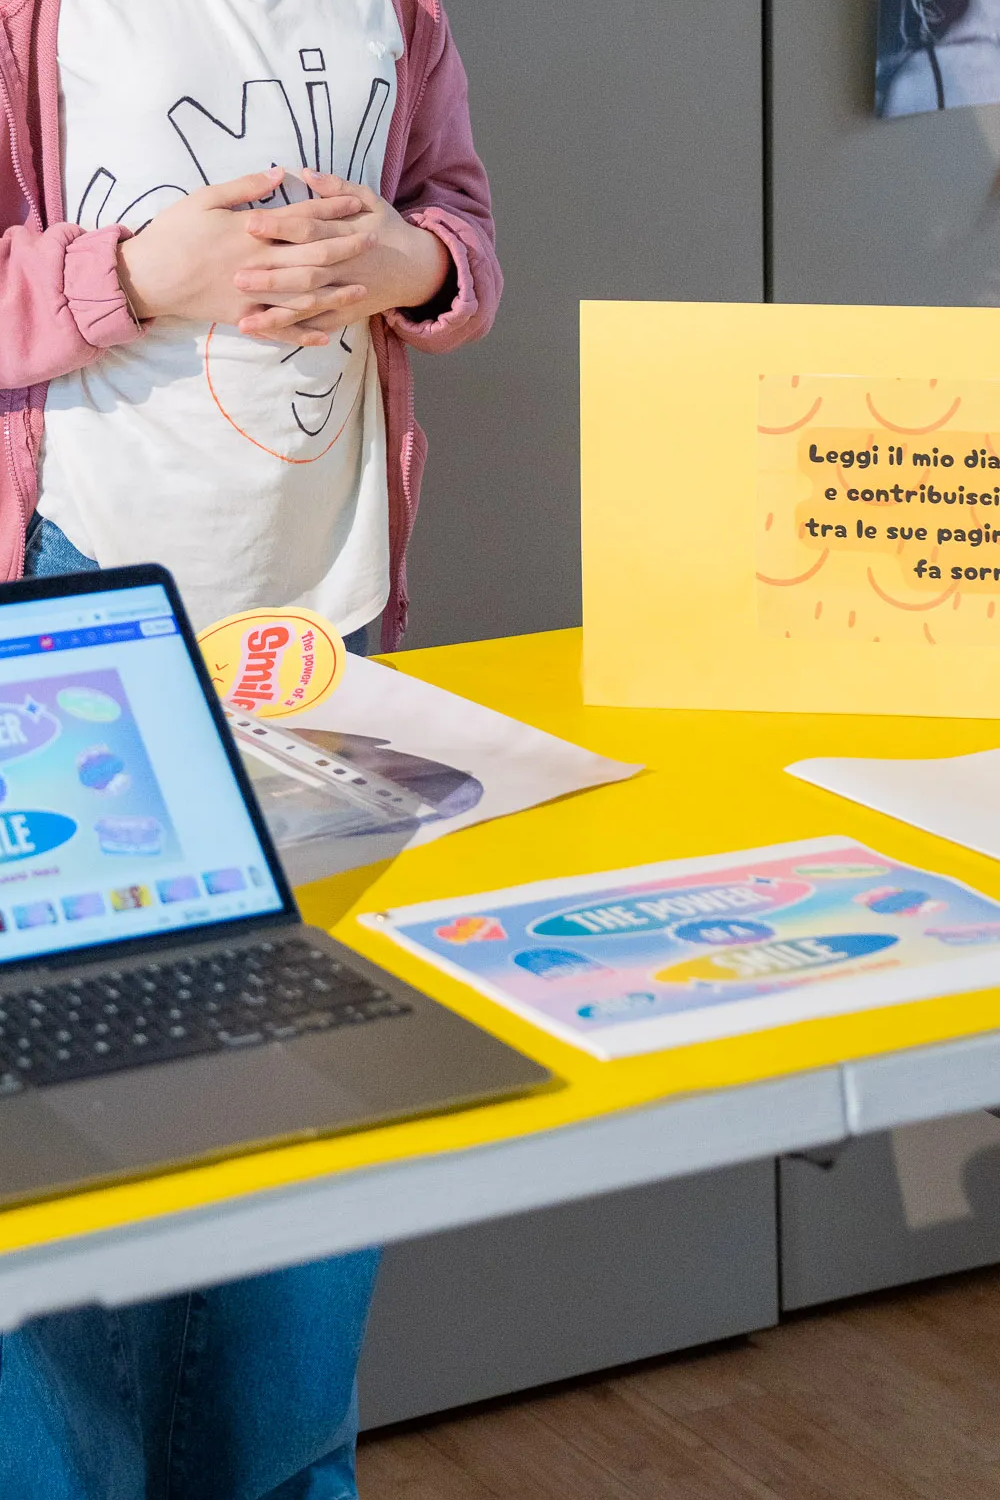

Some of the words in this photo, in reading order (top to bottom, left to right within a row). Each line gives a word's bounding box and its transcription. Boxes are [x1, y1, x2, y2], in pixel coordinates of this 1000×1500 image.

[808, 444, 879, 469] Leggi
[888, 445, 903, 466] il
[912, 447, 954, 468] mio
[824, 487, 837, 500] e
[846, 483, 1000, 506] contribuisci
[805, 518, 847, 538] tra
[856, 519, 877, 539] le
[886, 526, 928, 540] sue
[913, 559, 941, 579] fa
[301, 630, 315, 652] The
[300, 653, 314, 685] power
[292, 687, 304, 699] of
[564, 904, 649, 934] THE
[636, 883, 775, 922] POWER
[710, 938, 849, 977] SMILE
